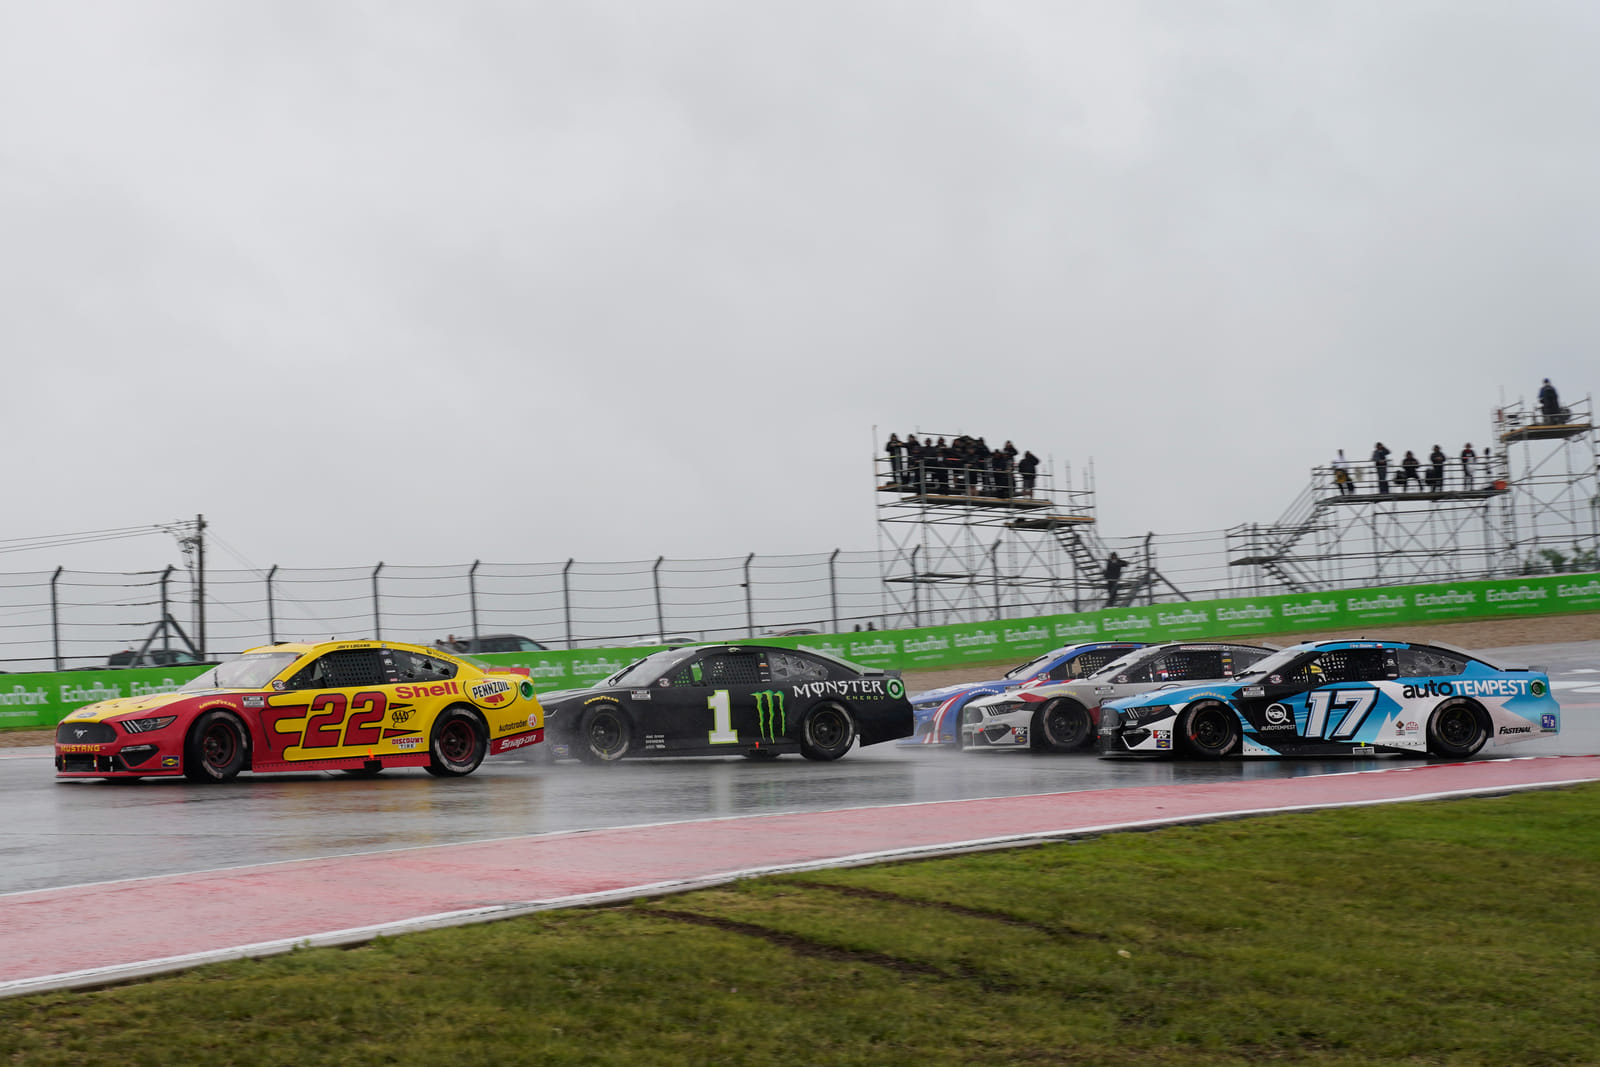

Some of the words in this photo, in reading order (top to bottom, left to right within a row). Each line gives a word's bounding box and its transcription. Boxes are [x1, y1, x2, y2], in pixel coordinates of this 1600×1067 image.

[60, 681, 123, 703] EchoPark
[395, 681, 459, 699] Shell
[471, 680, 511, 700] PENNZOIL
[792, 680, 885, 699] MONSTER
[1403, 679, 1529, 699] autoTEMPEST
[301, 691, 387, 749] 22
[707, 689, 739, 745] 1
[1303, 688, 1379, 740] 17
[498, 719, 528, 732] Autotrader
[60, 744, 101, 752] MUSTANG
[391, 737, 424, 745] DISCOUNT
[500, 734, 537, 750] Snap-on
